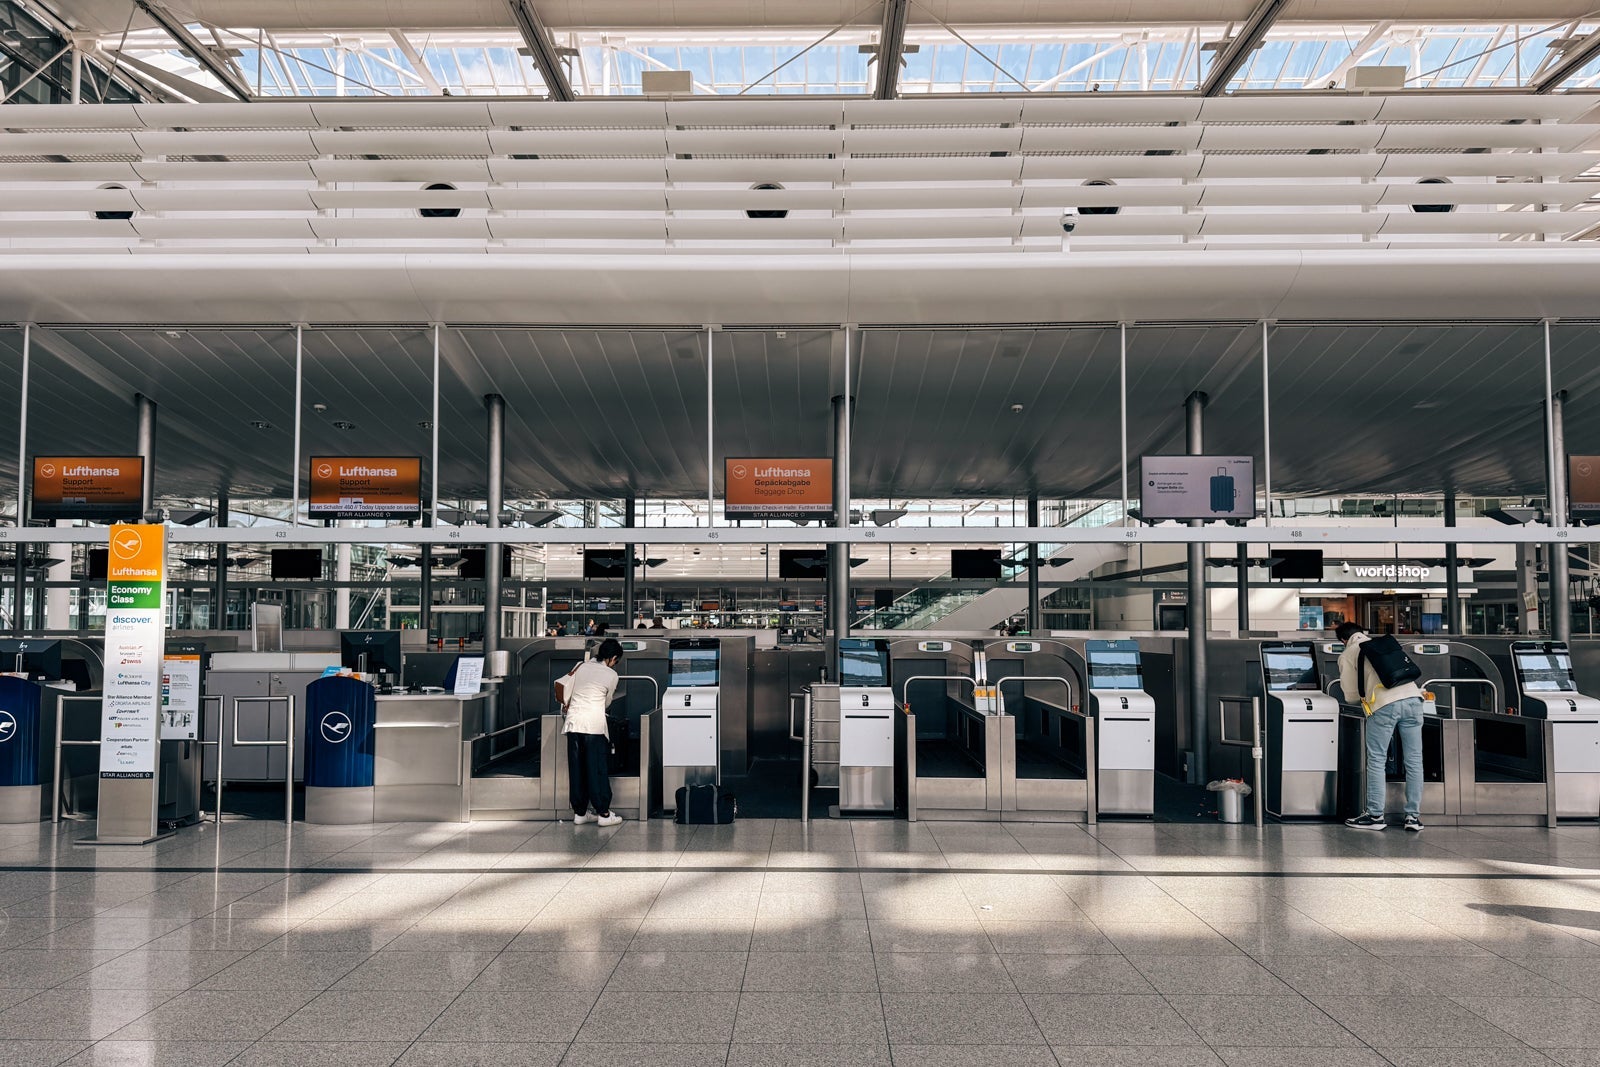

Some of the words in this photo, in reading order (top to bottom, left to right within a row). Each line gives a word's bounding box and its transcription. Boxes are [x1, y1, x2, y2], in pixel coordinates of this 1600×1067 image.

[63, 466, 120, 476] Lufthansa
[340, 466, 398, 476] Lufthansa
[754, 467, 811, 477] Lufthansa
[112, 568, 157, 576] Lufthansa
[1356, 565, 1430, 580] worldshop
[111, 586, 152, 595] Economy
